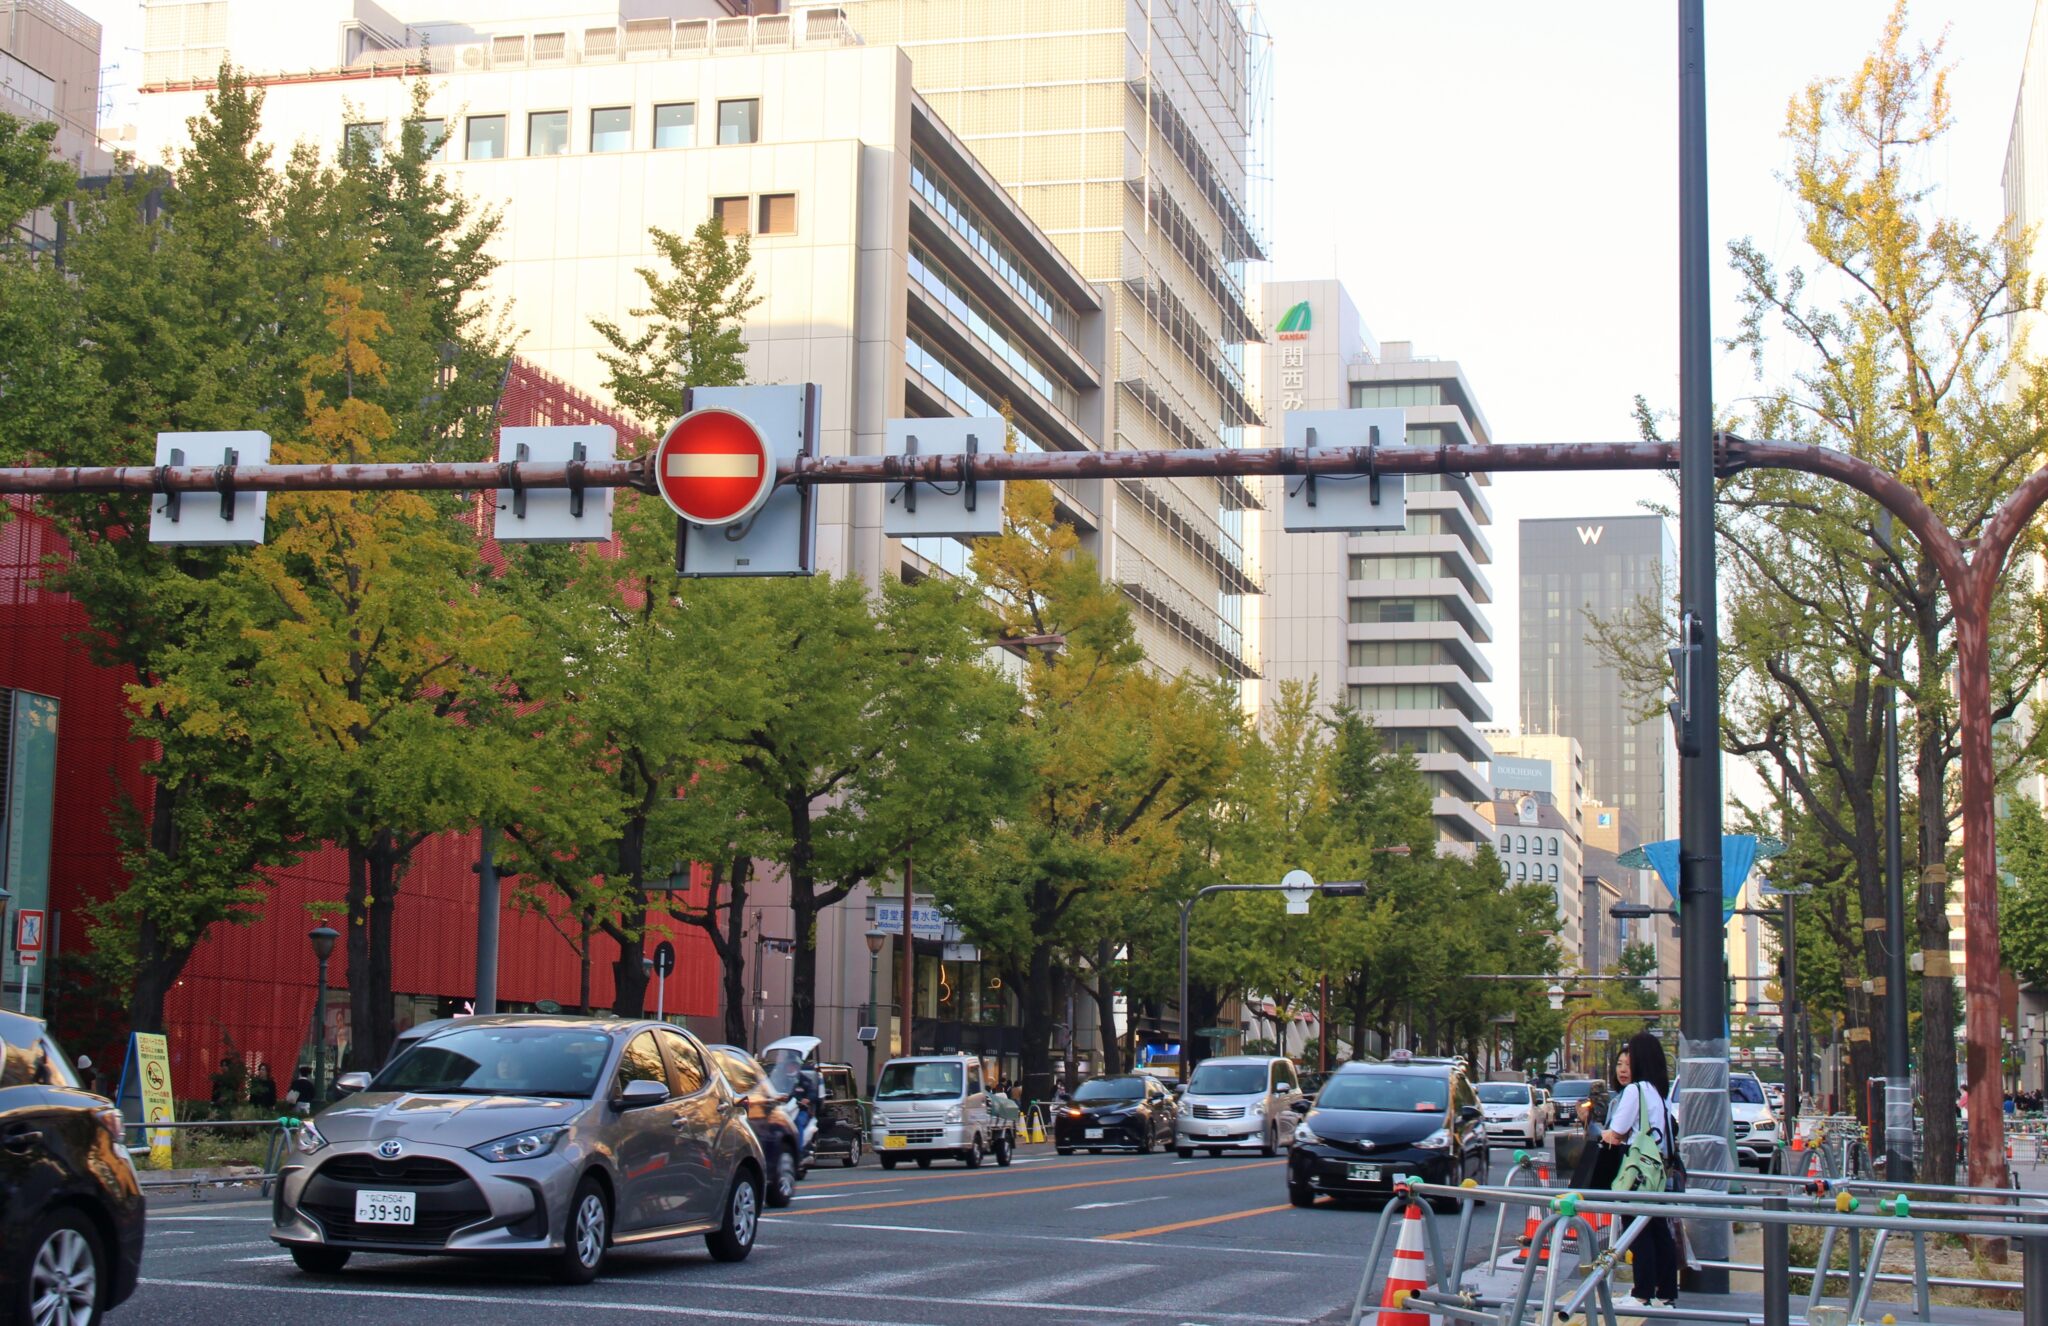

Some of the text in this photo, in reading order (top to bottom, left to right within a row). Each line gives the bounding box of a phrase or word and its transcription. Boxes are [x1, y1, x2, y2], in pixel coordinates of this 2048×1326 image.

[1279, 333, 1307, 341] KANSAI
[1576, 525, 1604, 545] W
[1497, 766, 1542, 777] BOUCHERON
[879, 909, 941, 922] 御堂清水町
[369, 1204, 412, 1222] 39-90
